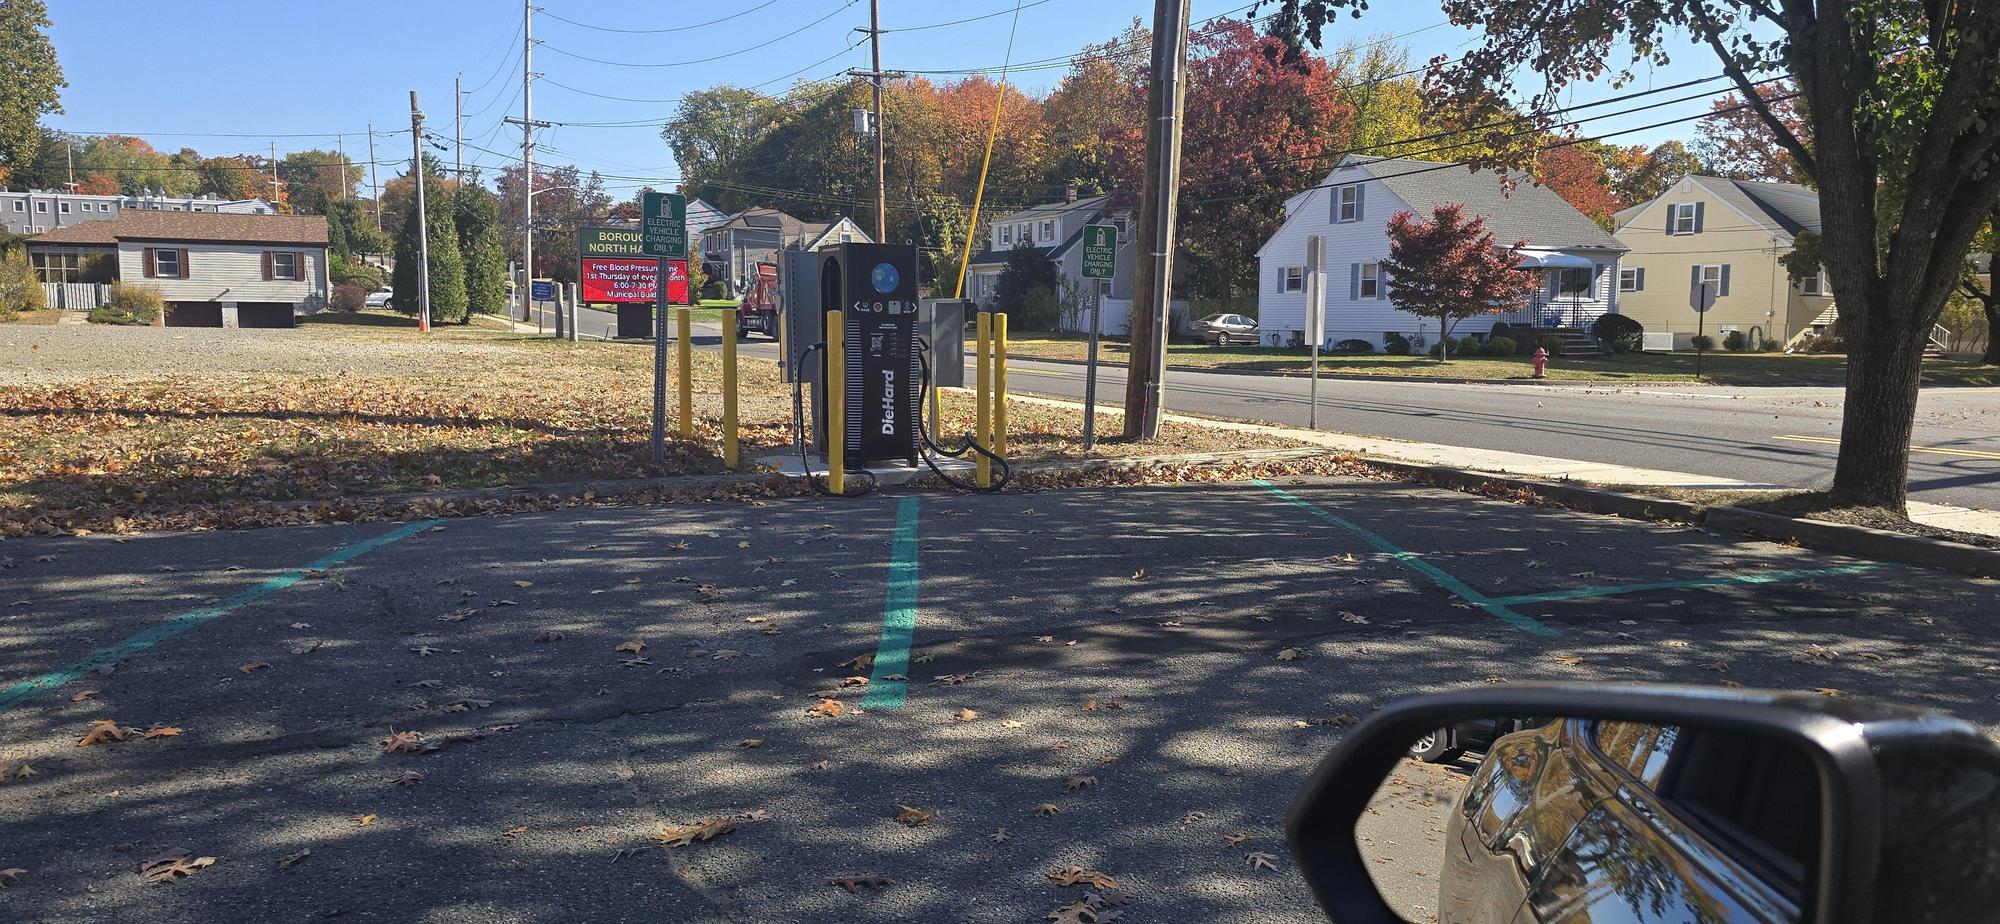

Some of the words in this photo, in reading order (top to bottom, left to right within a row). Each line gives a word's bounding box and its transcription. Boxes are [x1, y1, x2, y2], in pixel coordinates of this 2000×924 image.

[648, 218, 681, 227] ELECTRIC
[650, 227, 679, 236] VEHICLE
[646, 235, 682, 244] CHARGING
[589, 242, 627, 253] NORTH
[653, 243, 674, 252] ONLY
[592, 263, 608, 271] Free
[609, 263, 630, 271] Blood
[630, 264, 658, 272] Pressur
[586, 272, 598, 280] 1st
[599, 272, 631, 282] Thursday
[632, 273, 640, 281] of
[606, 290, 640, 299] Municipal
[640, 291, 657, 299] Build
[882, 369, 894, 434] DieHard
